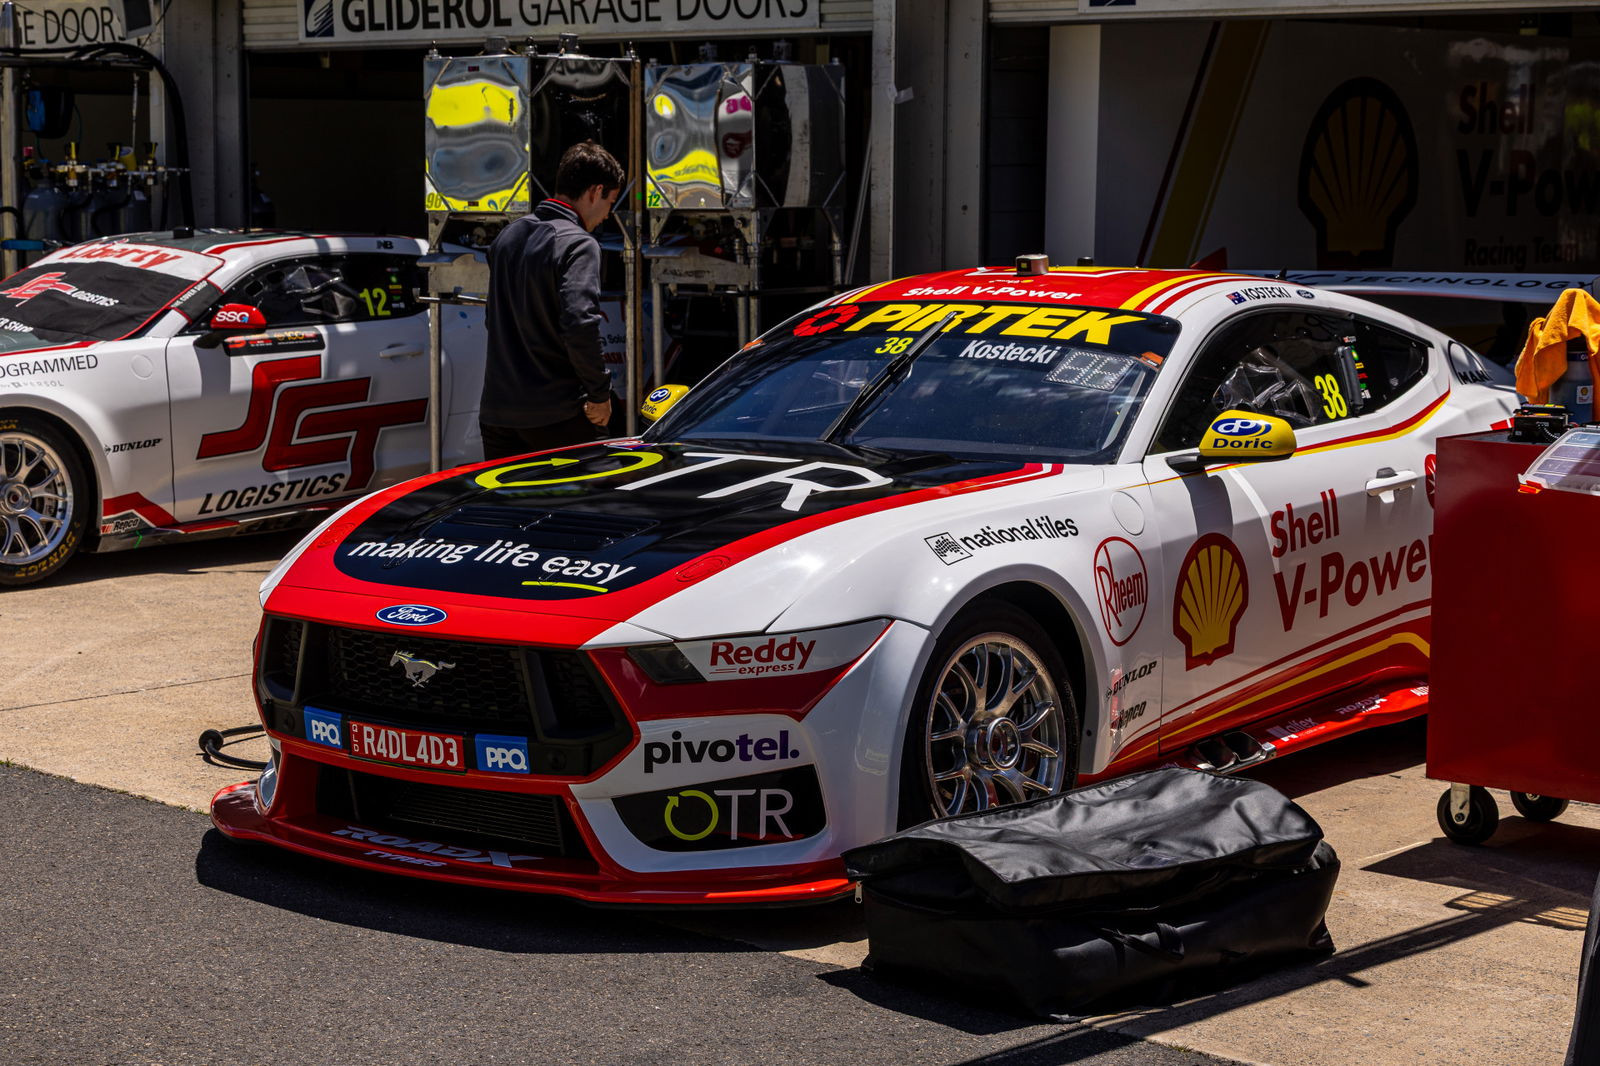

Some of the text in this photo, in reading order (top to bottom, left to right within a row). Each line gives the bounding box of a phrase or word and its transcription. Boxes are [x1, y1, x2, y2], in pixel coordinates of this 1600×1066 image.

[342, 0, 808, 32] GLIDEROL GARAGE DOORS
[1458, 82, 1536, 135] Shell
[59, 238, 182, 269] Liberty
[1465, 236, 1581, 271] Racing Team
[67, 288, 120, 308] LOGISTICS
[901, 285, 1082, 301] Shell V-Power
[1242, 286, 1291, 303] KOSTECKI
[1342, 276, 1593, 290] TECHNOLOGY
[359, 287, 392, 317] 12
[845, 303, 1147, 345] PIRTEK
[873, 338, 914, 355] 38
[959, 340, 1061, 365] Kostecki
[1314, 373, 1348, 420] 38
[112, 438, 163, 453] DUNLOP
[1212, 437, 1273, 450] Doric
[198, 473, 345, 516] LOGISTICS
[113, 517, 141, 532] Repco
[1270, 488, 1340, 558] Shell
[347, 537, 636, 587] making life easy
[1096, 545, 1146, 631] Rheem
[386, 606, 438, 623] Ford
[710, 635, 816, 669] Reddy
[738, 663, 795, 676] express
[1112, 660, 1158, 697] DUNLOP
[1118, 700, 1147, 728] Repco
[310, 719, 341, 746] PPQ
[363, 725, 459, 768] R4DL4D3
[486, 746, 528, 770] PPQ
[644, 730, 800, 774] pivotel.
[331, 826, 544, 868] ROADX
